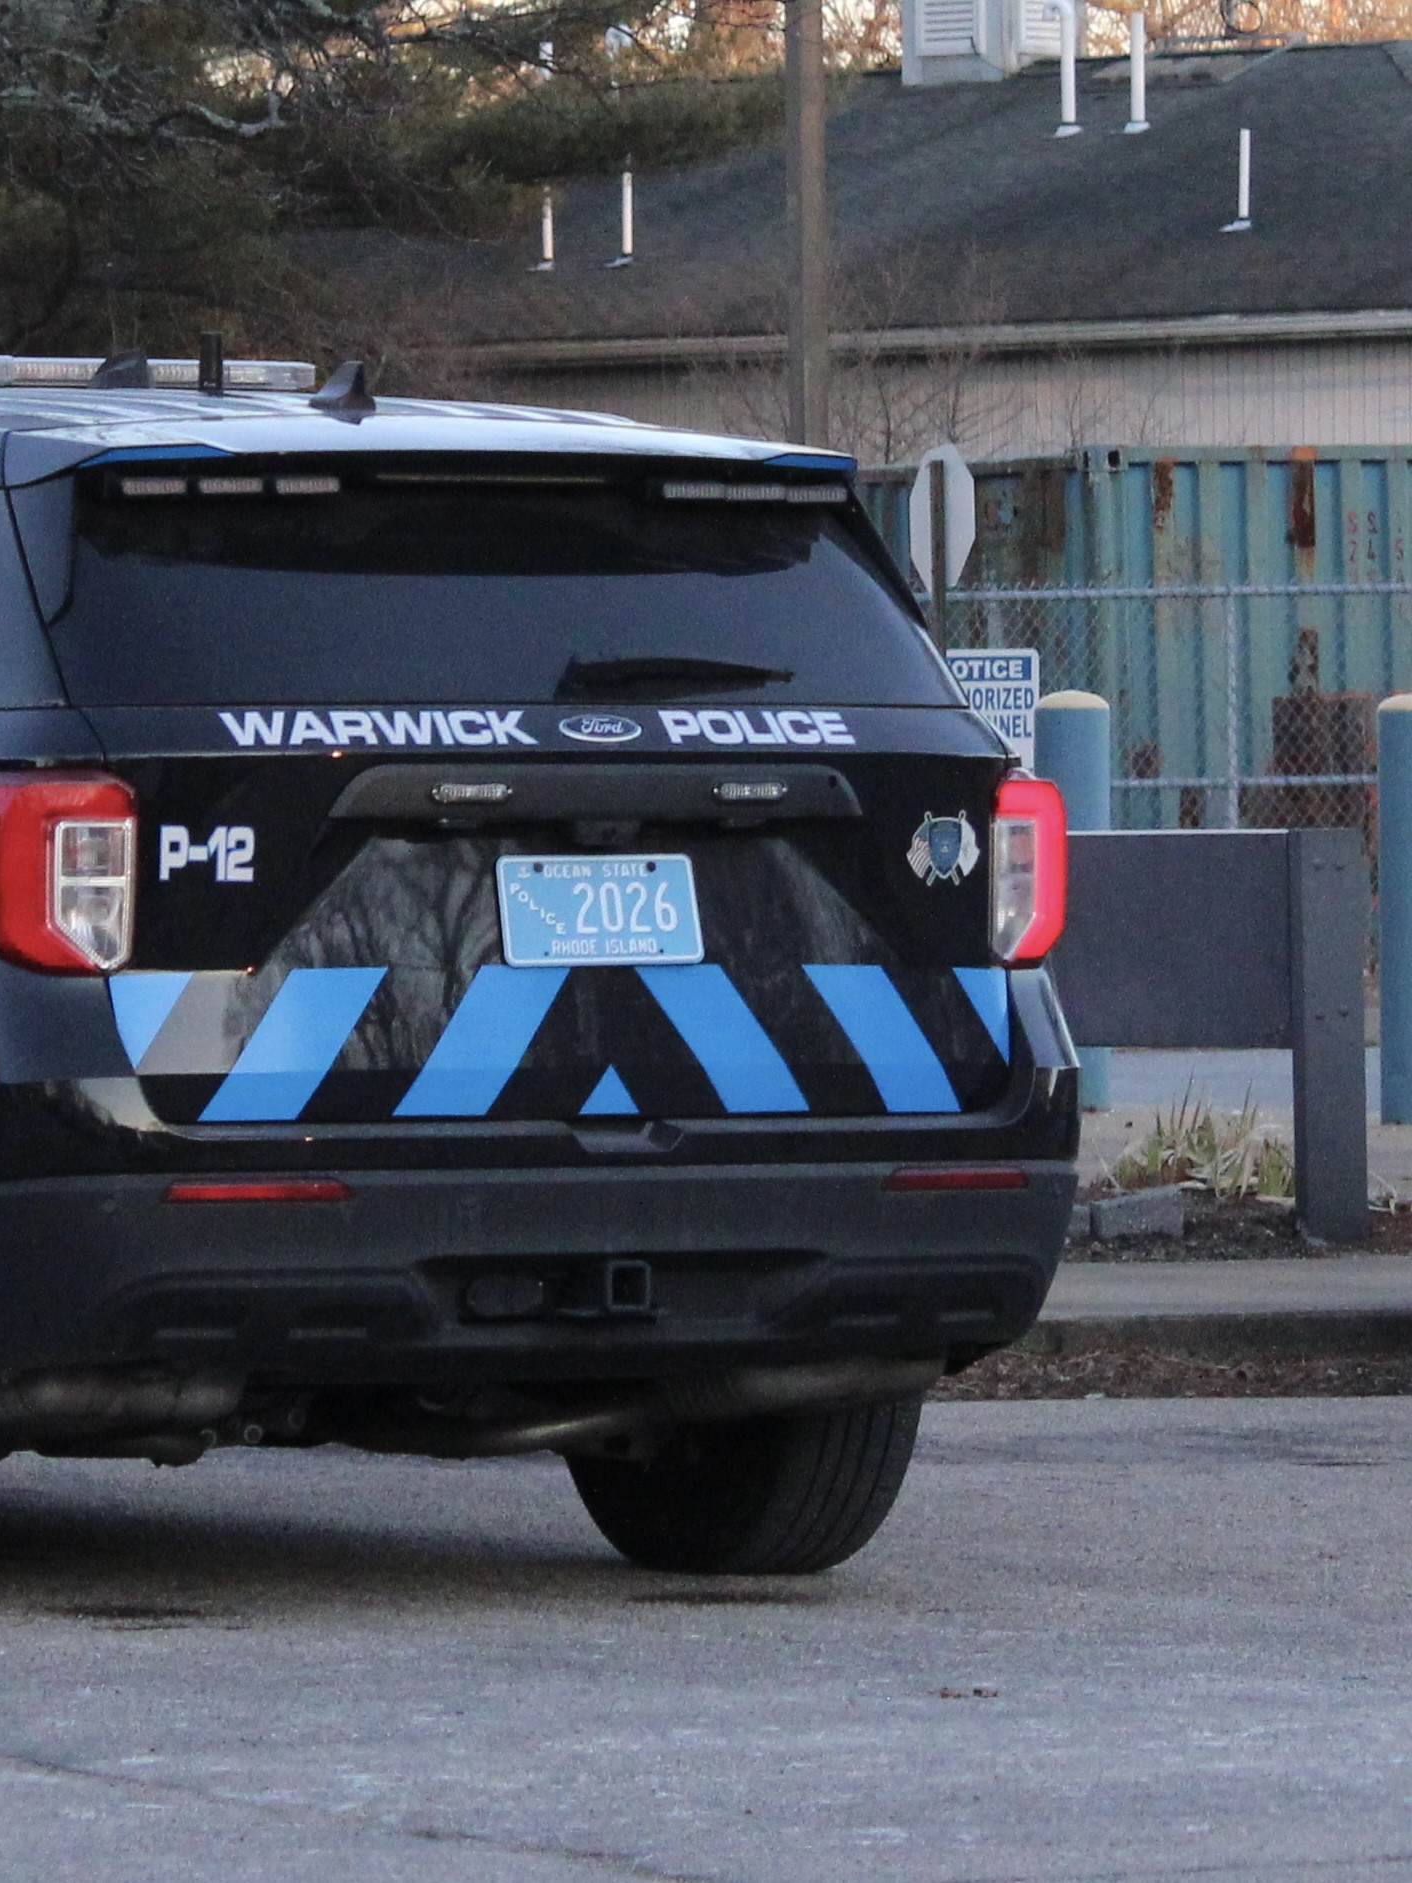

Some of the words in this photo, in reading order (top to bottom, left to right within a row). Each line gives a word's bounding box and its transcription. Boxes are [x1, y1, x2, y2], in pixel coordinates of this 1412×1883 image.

[948, 659, 1024, 679] OTICE
[218, 710, 539, 746] WARWICK
[658, 710, 856, 745] POLICE
[580, 715, 624, 736] Ford
[159, 825, 255, 882] P-12
[543, 863, 592, 878] OCEAN
[602, 863, 648, 877] STATE
[510, 882, 567, 935] POLICE
[573, 881, 679, 935] 2026
[551, 939, 598, 955] RHODE
[605, 938, 657, 955] ISLAND
